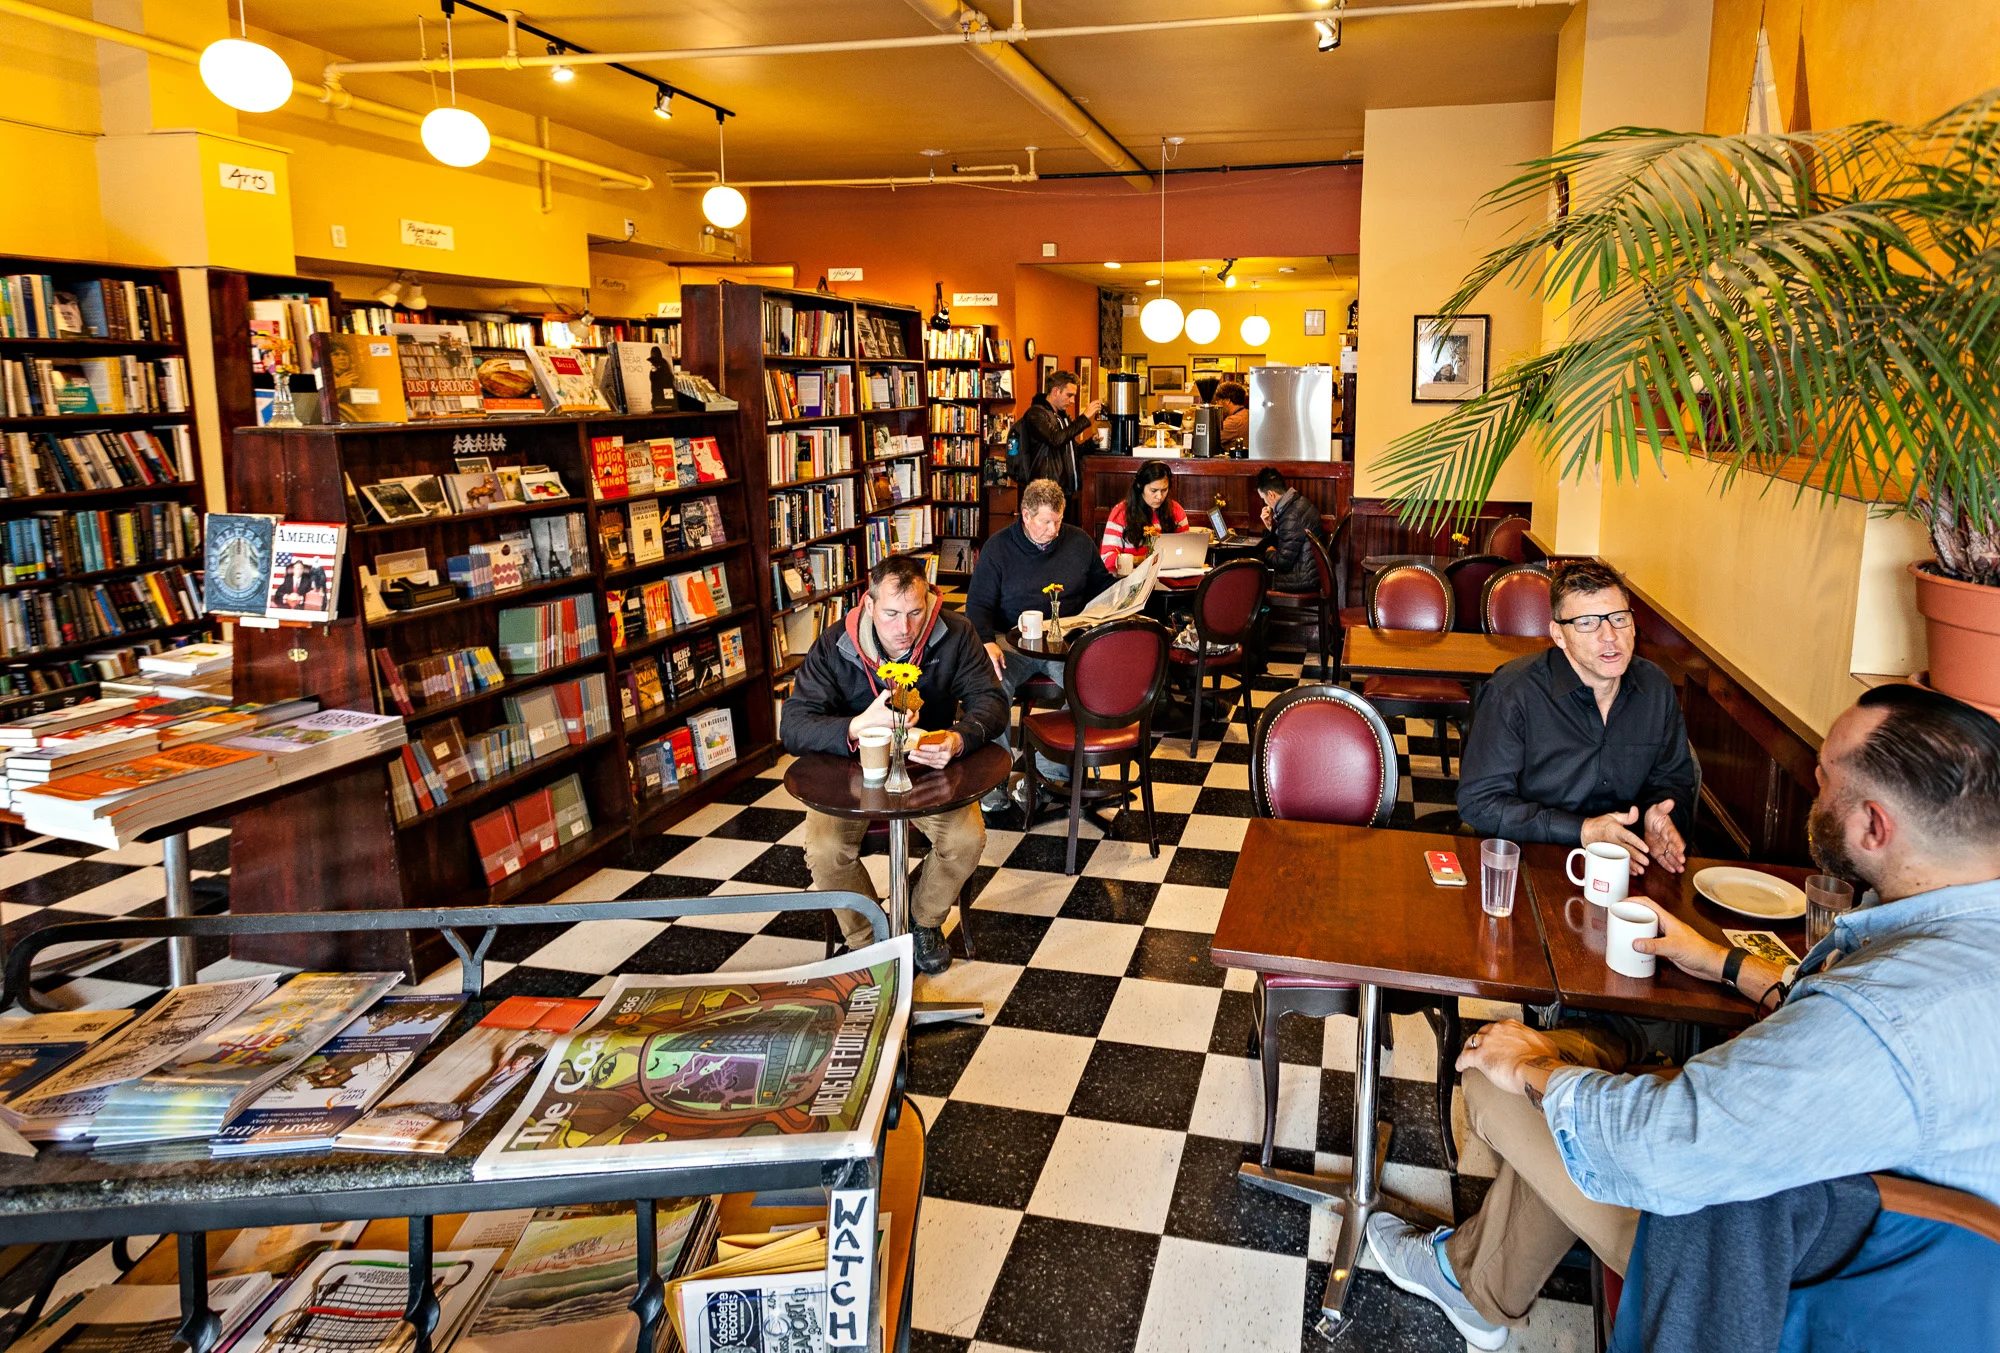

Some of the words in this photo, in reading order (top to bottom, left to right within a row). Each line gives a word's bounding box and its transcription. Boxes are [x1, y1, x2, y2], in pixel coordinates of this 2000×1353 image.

[228, 168, 268, 190] Arts
[621, 346, 634, 355] SEE
[623, 355, 641, 364] HEAR
[625, 364, 643, 373] YOKO
[406, 380, 429, 393] DUST
[430, 380, 439, 392] &
[439, 380, 475, 392] GROOVES
[596, 451, 623, 465] MAJOR
[626, 457, 651, 469] RACULA
[598, 476, 626, 488] MINOR
[633, 512, 658, 521] IMAGINE
[278, 529, 337, 545] AMERICA
[672, 647, 691, 663] QUEBEC
[677, 658, 689, 671] CITY
[618, 996, 641, 1014] 666
[830, 1022, 871, 1060] FUTURE
[824, 1060, 859, 1079] OF
[808, 1080, 850, 1117] OMENS
[217, 1124, 275, 1137] WALKS
[275, 1122, 334, 1134] GHOST
[394, 1119, 430, 1127] DANCE
[510, 1102, 571, 1149] The
[829, 1195, 868, 1340] WATCH
[716, 1292, 729, 1345] obsolete
[728, 1293, 739, 1342] records
[806, 1307, 822, 1336] Blonde
